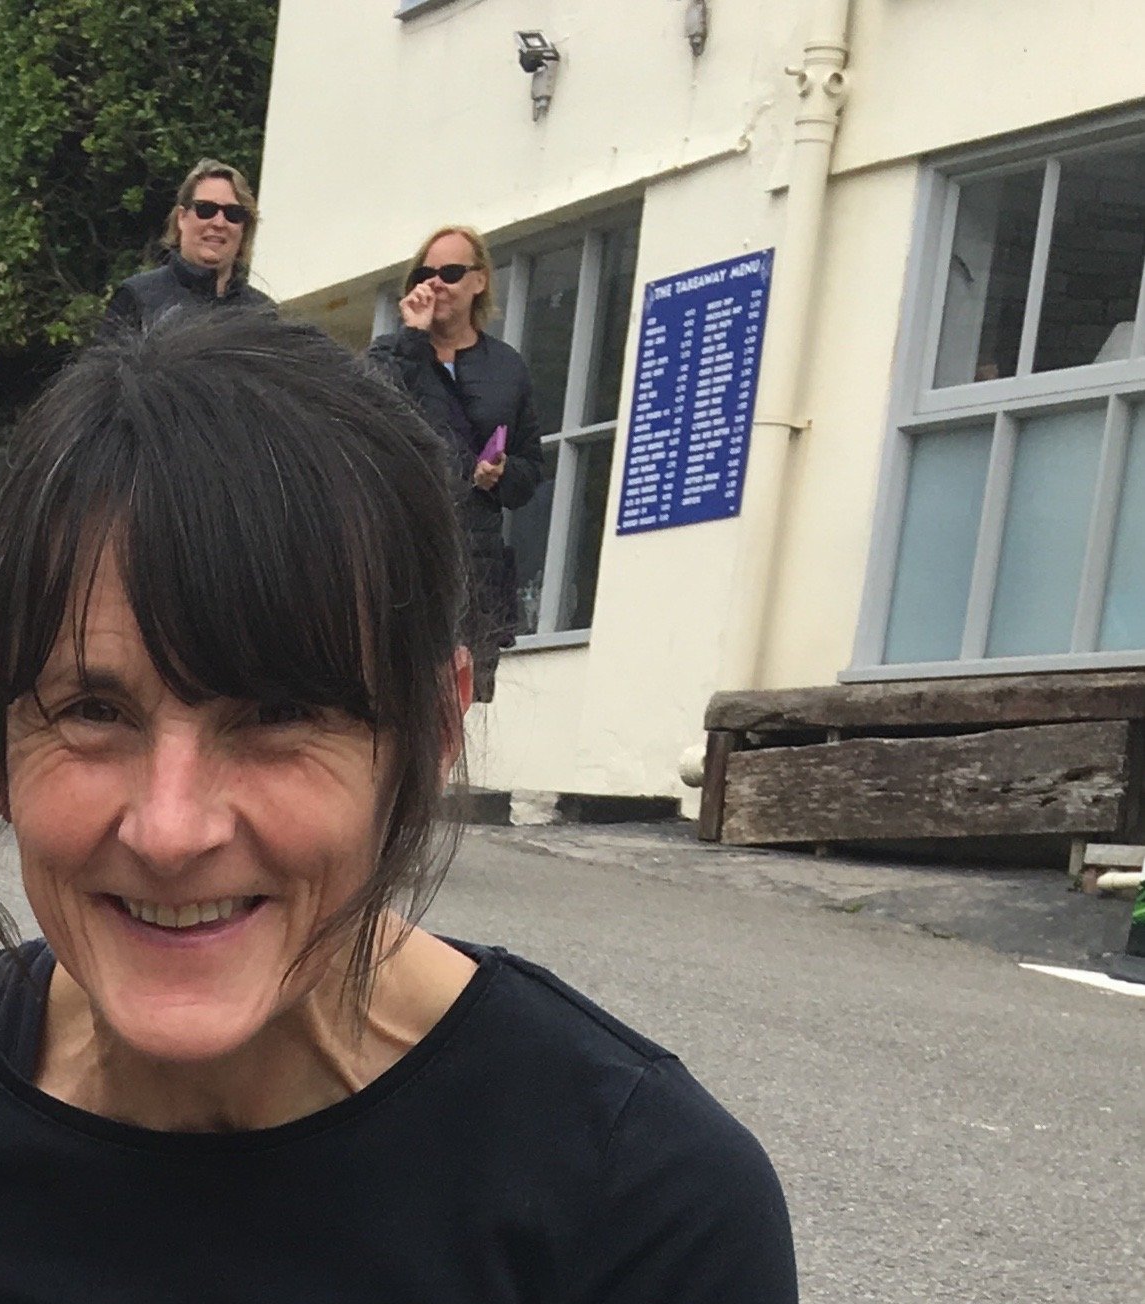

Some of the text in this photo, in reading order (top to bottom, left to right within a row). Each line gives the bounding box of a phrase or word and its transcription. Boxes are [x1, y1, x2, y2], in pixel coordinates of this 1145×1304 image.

[654, 259, 761, 300] THE TAKEAWAY MENU
